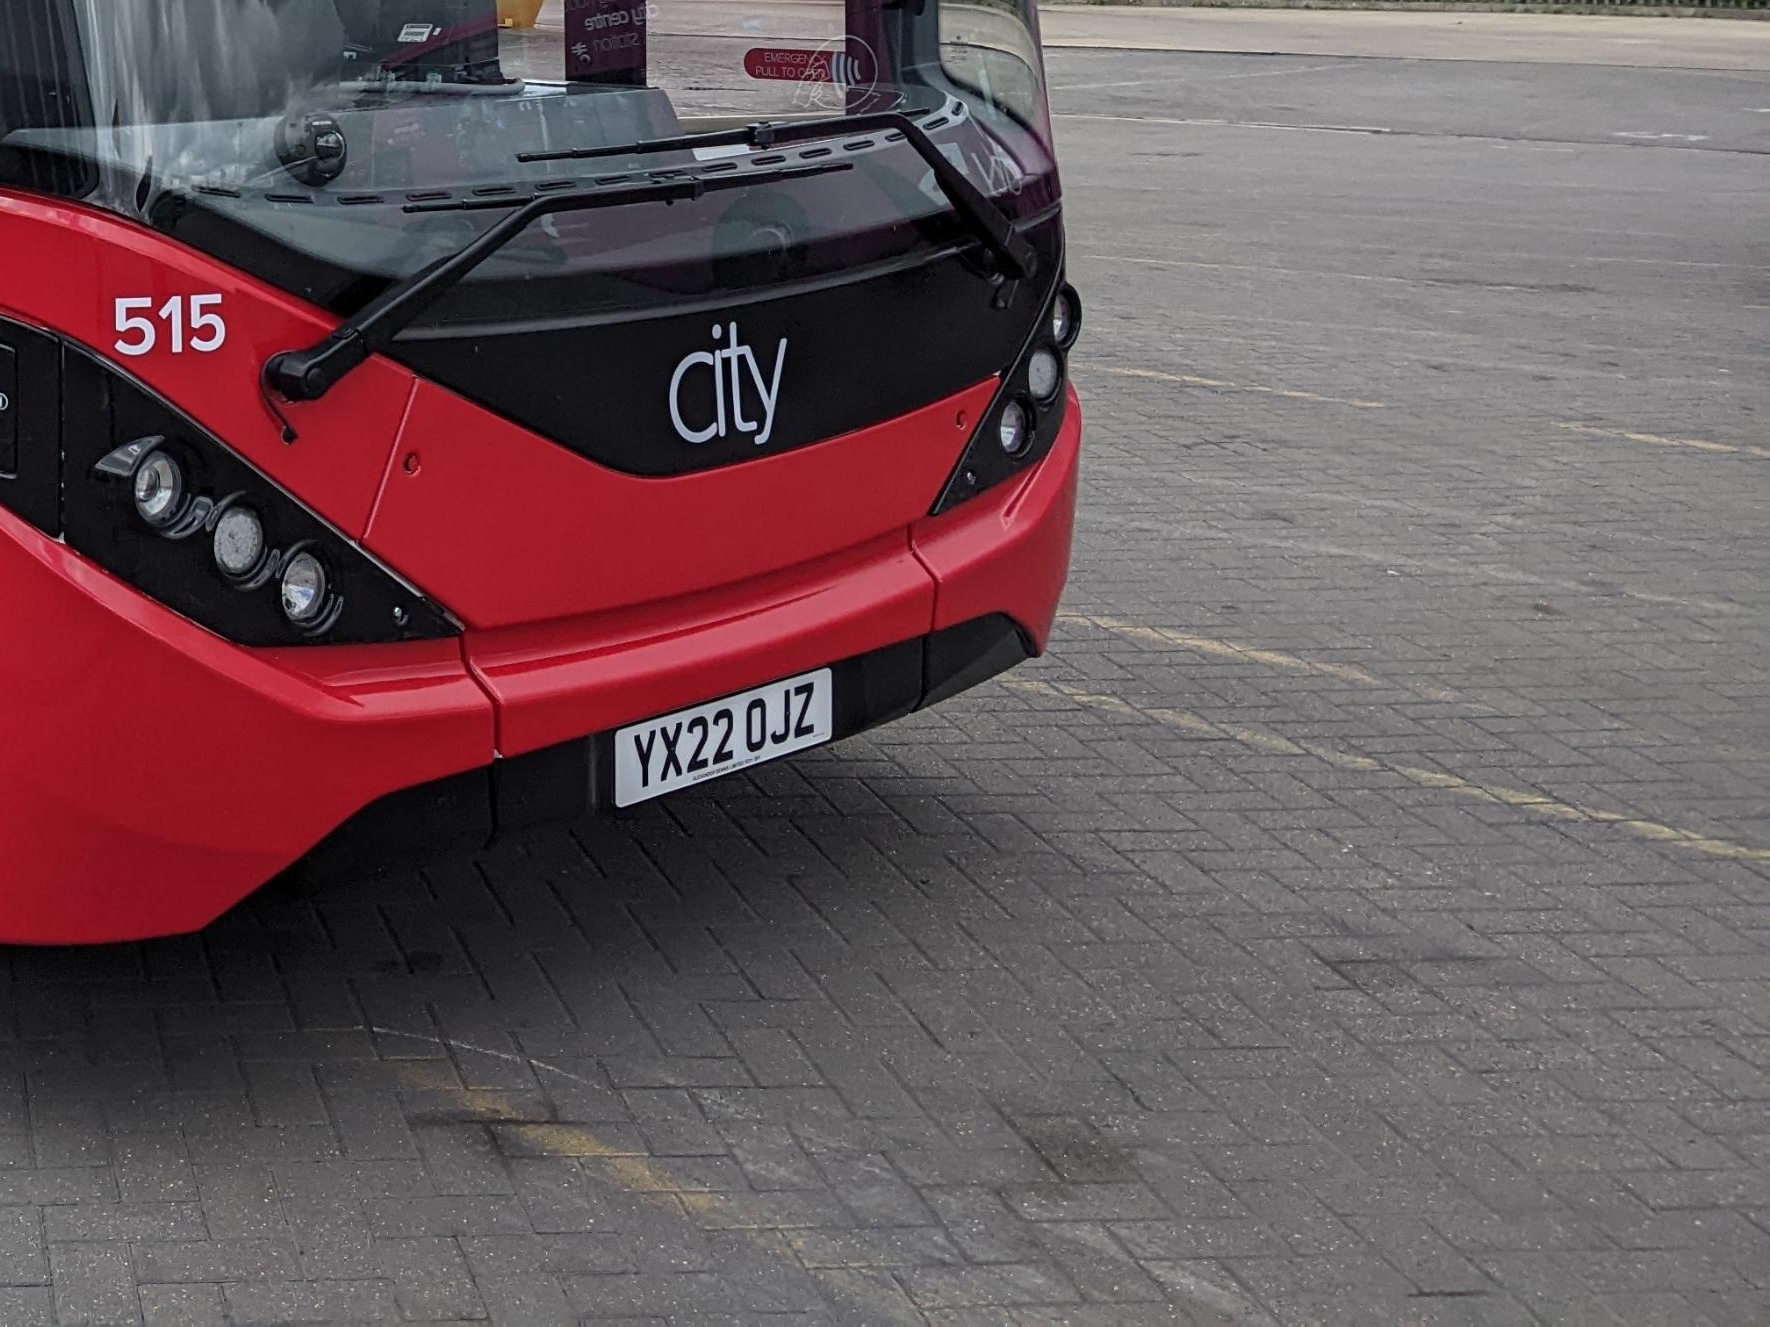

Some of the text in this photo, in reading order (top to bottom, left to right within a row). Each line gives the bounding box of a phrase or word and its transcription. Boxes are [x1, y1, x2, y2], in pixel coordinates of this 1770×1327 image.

[755, 65, 779, 77] PULL
[781, 66, 796, 78] TO
[114, 293, 227, 356] 515
[668, 321, 788, 446] city
[633, 683, 816, 789] YX22 OJZ
